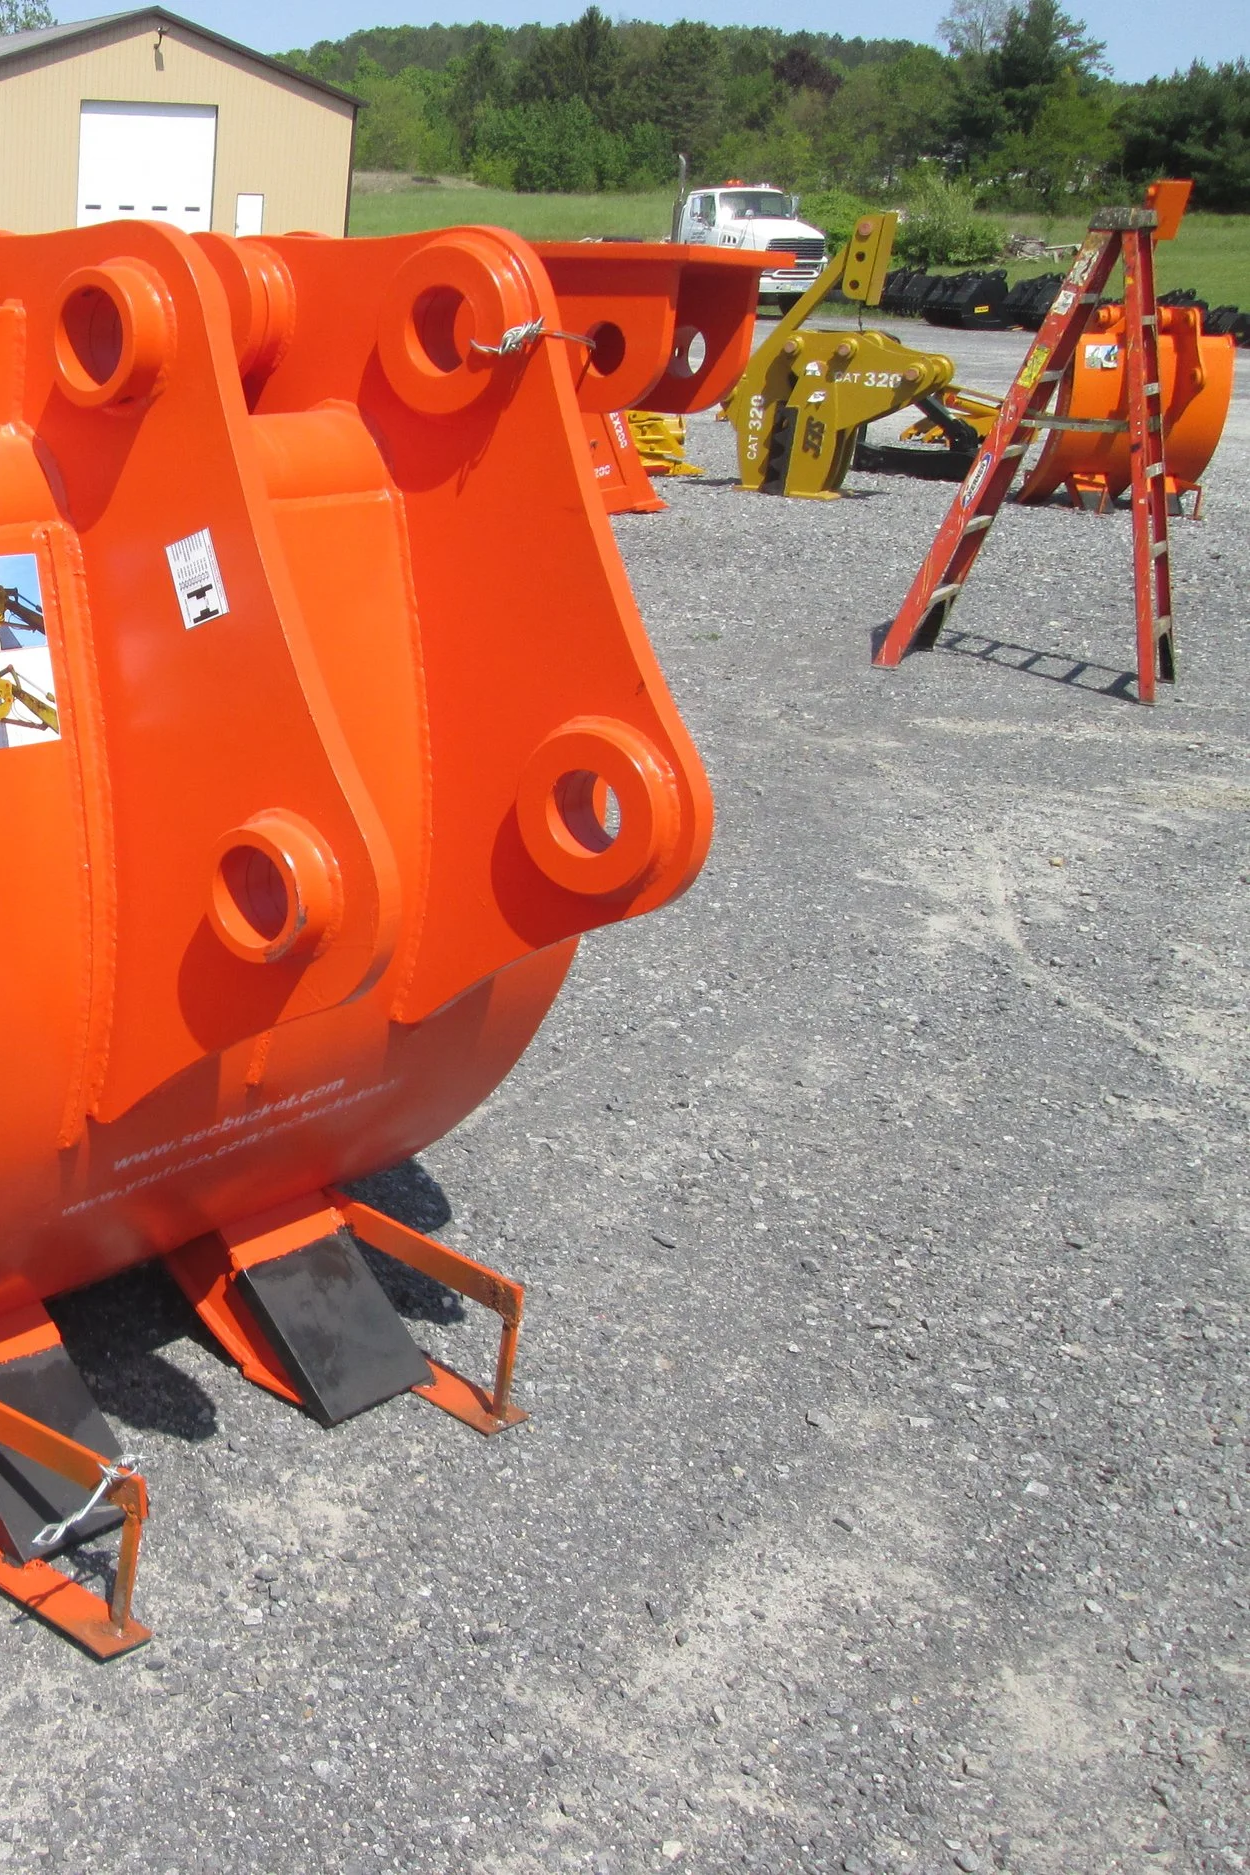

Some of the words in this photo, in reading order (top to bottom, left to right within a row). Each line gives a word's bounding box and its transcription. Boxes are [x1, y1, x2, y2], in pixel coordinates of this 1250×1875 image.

[835, 371, 861, 384] CAT
[863, 371, 902, 388] 320
[749, 395, 764, 431] 320
[746, 434, 759, 460] CAT
[113, 1077, 346, 1172] www.secbucket.com
